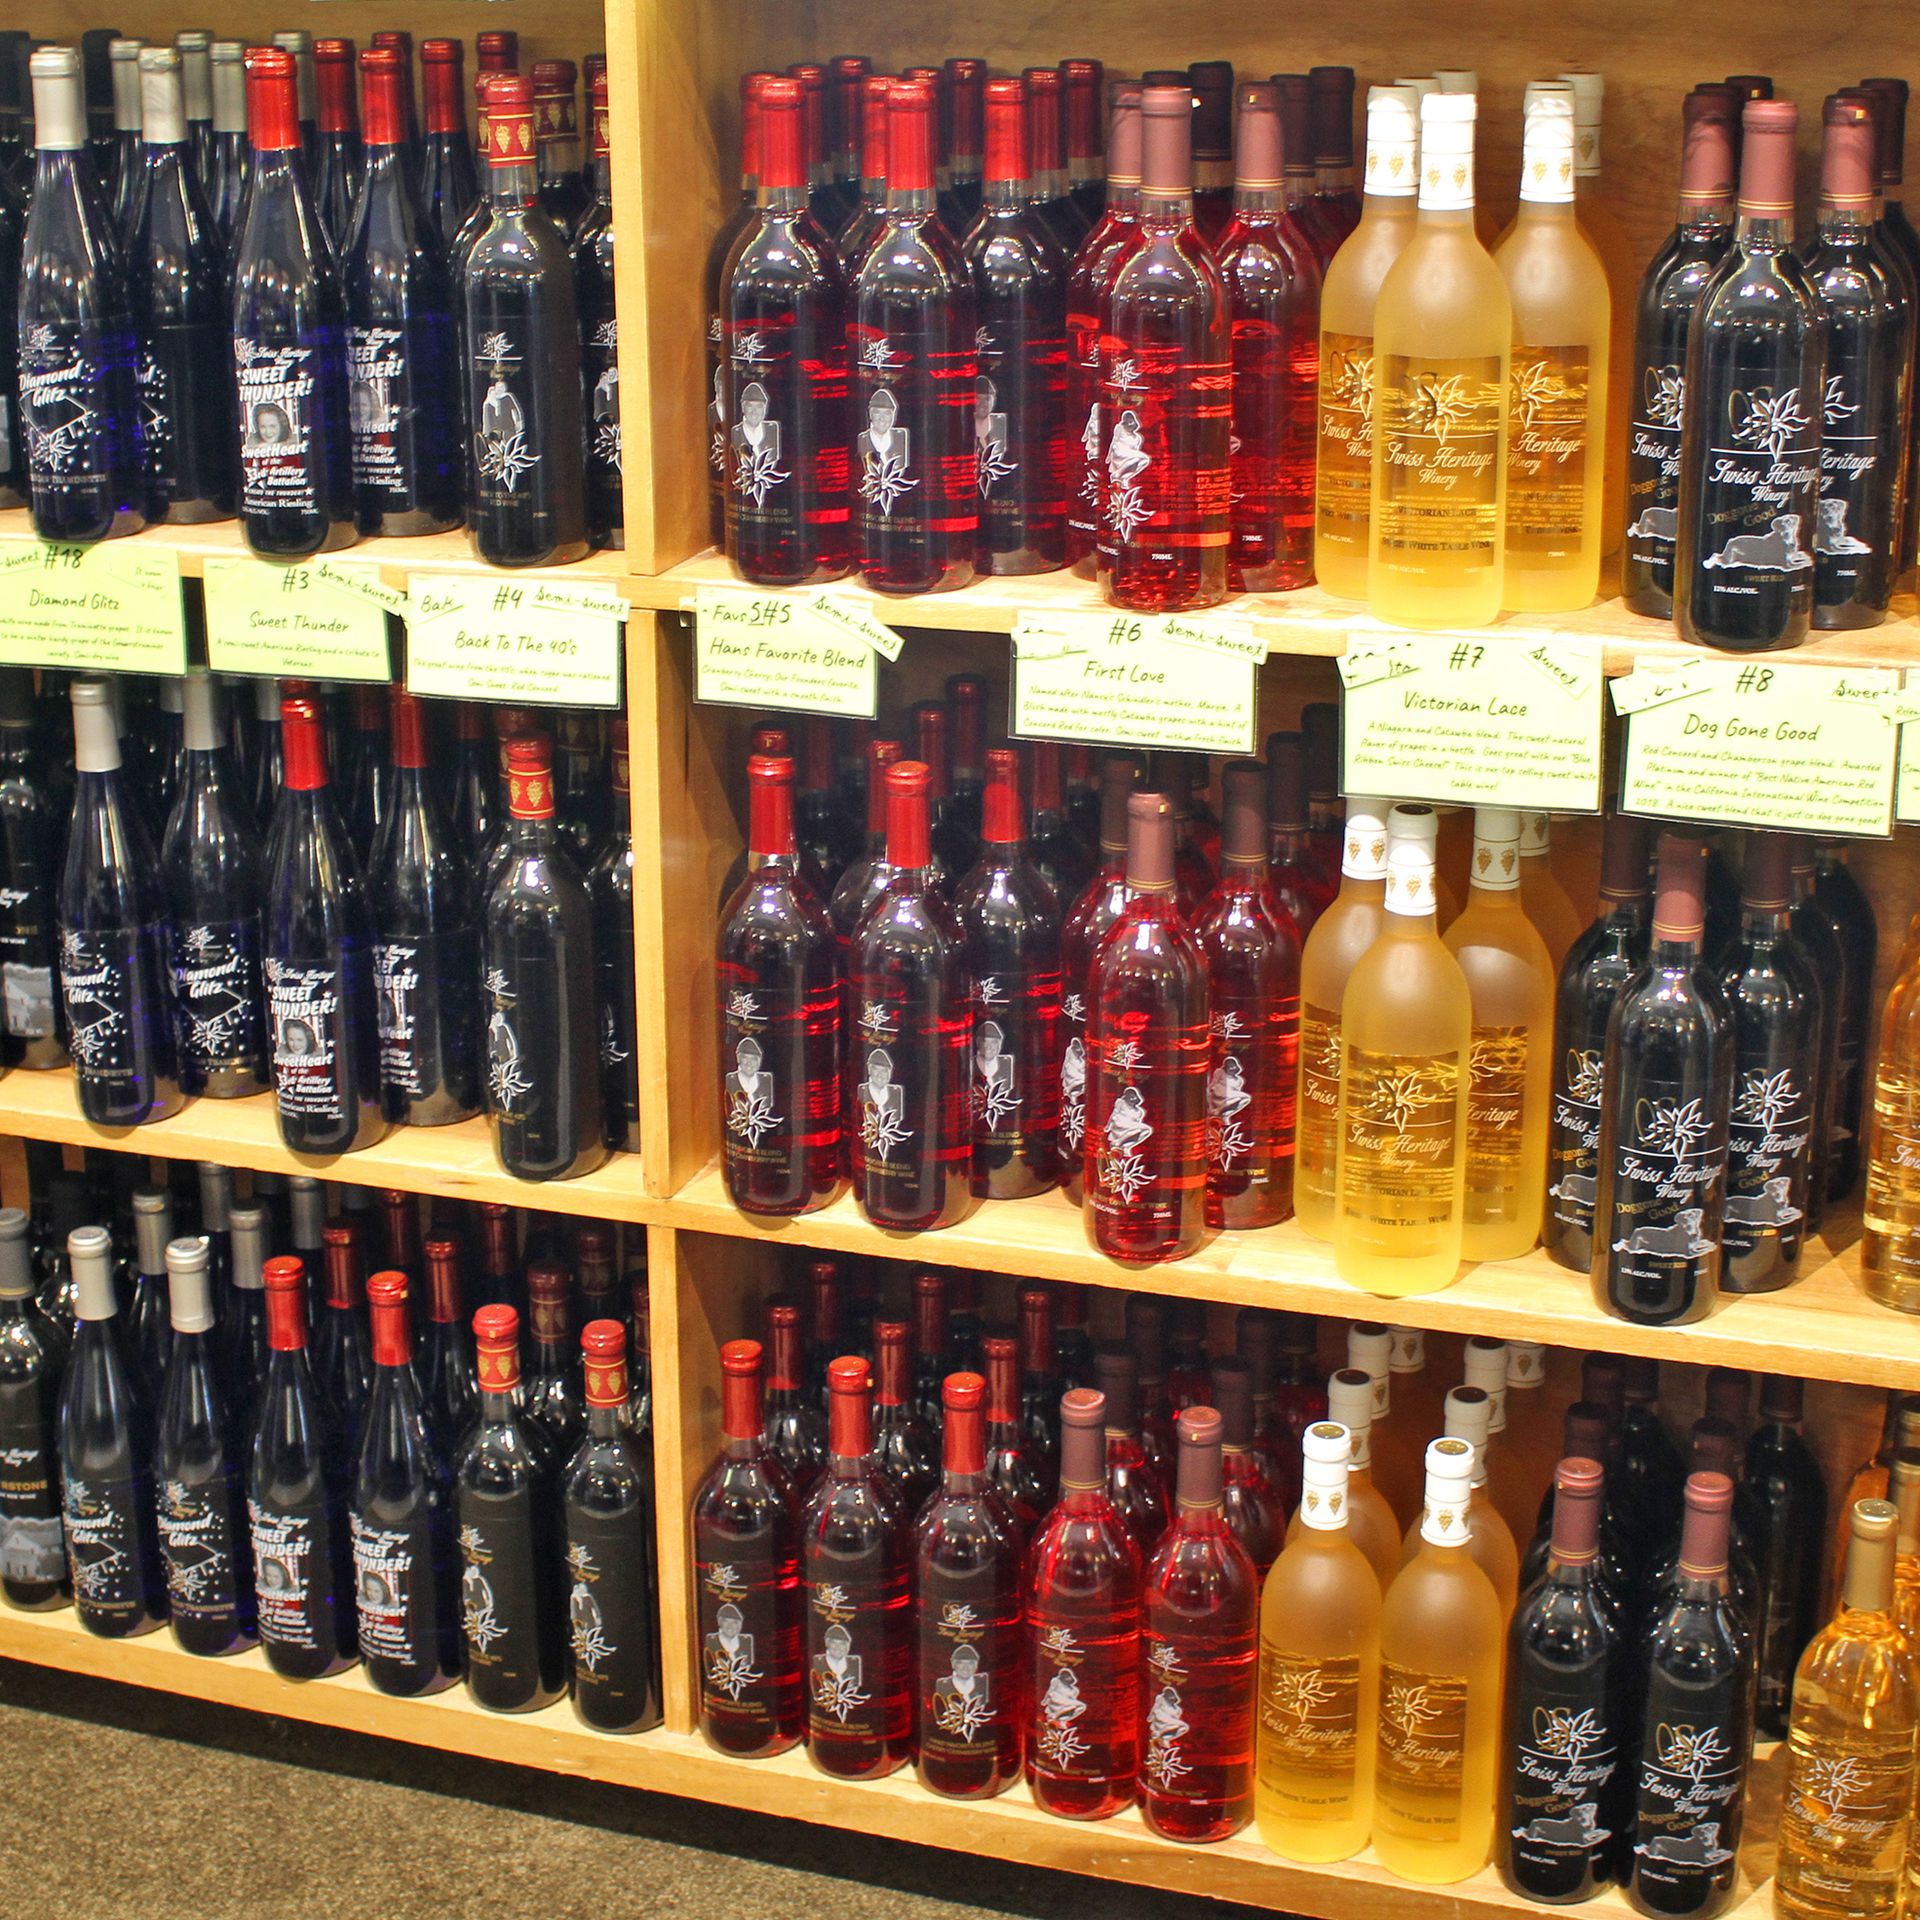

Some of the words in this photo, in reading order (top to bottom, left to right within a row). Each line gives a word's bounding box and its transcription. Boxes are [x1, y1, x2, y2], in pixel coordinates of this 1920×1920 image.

[19, 359, 84, 392] Diamond
[241, 366, 288, 385] SWEET
[33, 388, 67, 407] Glitz
[239, 377, 315, 402] THUNDER!
[1321, 414, 1349, 440] Swiss
[1512, 432, 1581, 463] Heritage
[1632, 432, 1667, 459] Swiss
[1384, 442, 1424, 468] Swiss
[1426, 447, 1495, 477] Heritage
[1710, 459, 1760, 485] Swiss
[1419, 469, 1458, 491] Winery
[1751, 486, 1792, 509] Winery
[44, 545, 84, 569] #18
[282, 568, 310, 592] #3
[29, 589, 86, 608] Diamond
[89, 593, 120, 610] Glitz
[492, 585, 524, 613] #4
[249, 610, 287, 629] Sweet
[294, 614, 350, 633] Thunder
[1108, 617, 1143, 646] #6
[455, 630, 490, 649] Back
[496, 634, 511, 651] To
[516, 635, 544, 653] The
[709, 636, 750, 656] Hans
[755, 642, 818, 664] Favorite
[822, 648, 867, 669] Blend
[1448, 642, 1485, 671] #7
[1083, 660, 1126, 681] First
[1129, 664, 1166, 684] Love
[1735, 665, 1774, 694] #8
[1403, 690, 1481, 713] Victorian
[1487, 696, 1528, 717] Lace
[1682, 713, 1718, 739] Dog
[1725, 717, 1769, 739] Gone
[1775, 721, 1822, 742] Good
[62, 966, 110, 987] amond
[189, 982, 224, 998] Glitz
[271, 985, 313, 1000] SWEET
[270, 997, 339, 1017] THUNDER!
[1304, 1079, 1337, 1105] Swiss
[1554, 1106, 1590, 1132] Swiss
[1348, 1124, 1384, 1150] Swiss
[1387, 1134, 1451, 1160] Heritage
[1618, 1157, 1661, 1183] Swiss
[1655, 1184, 1695, 1203] Winery
[1290, 1723, 1353, 1750] Heritage
[1399, 1739, 1460, 1768] Heritage
[1517, 1756, 1557, 1782] Swiss
[1640, 1772, 1679, 1799] Swiss
[1819, 1812, 1887, 1840] Heritage
